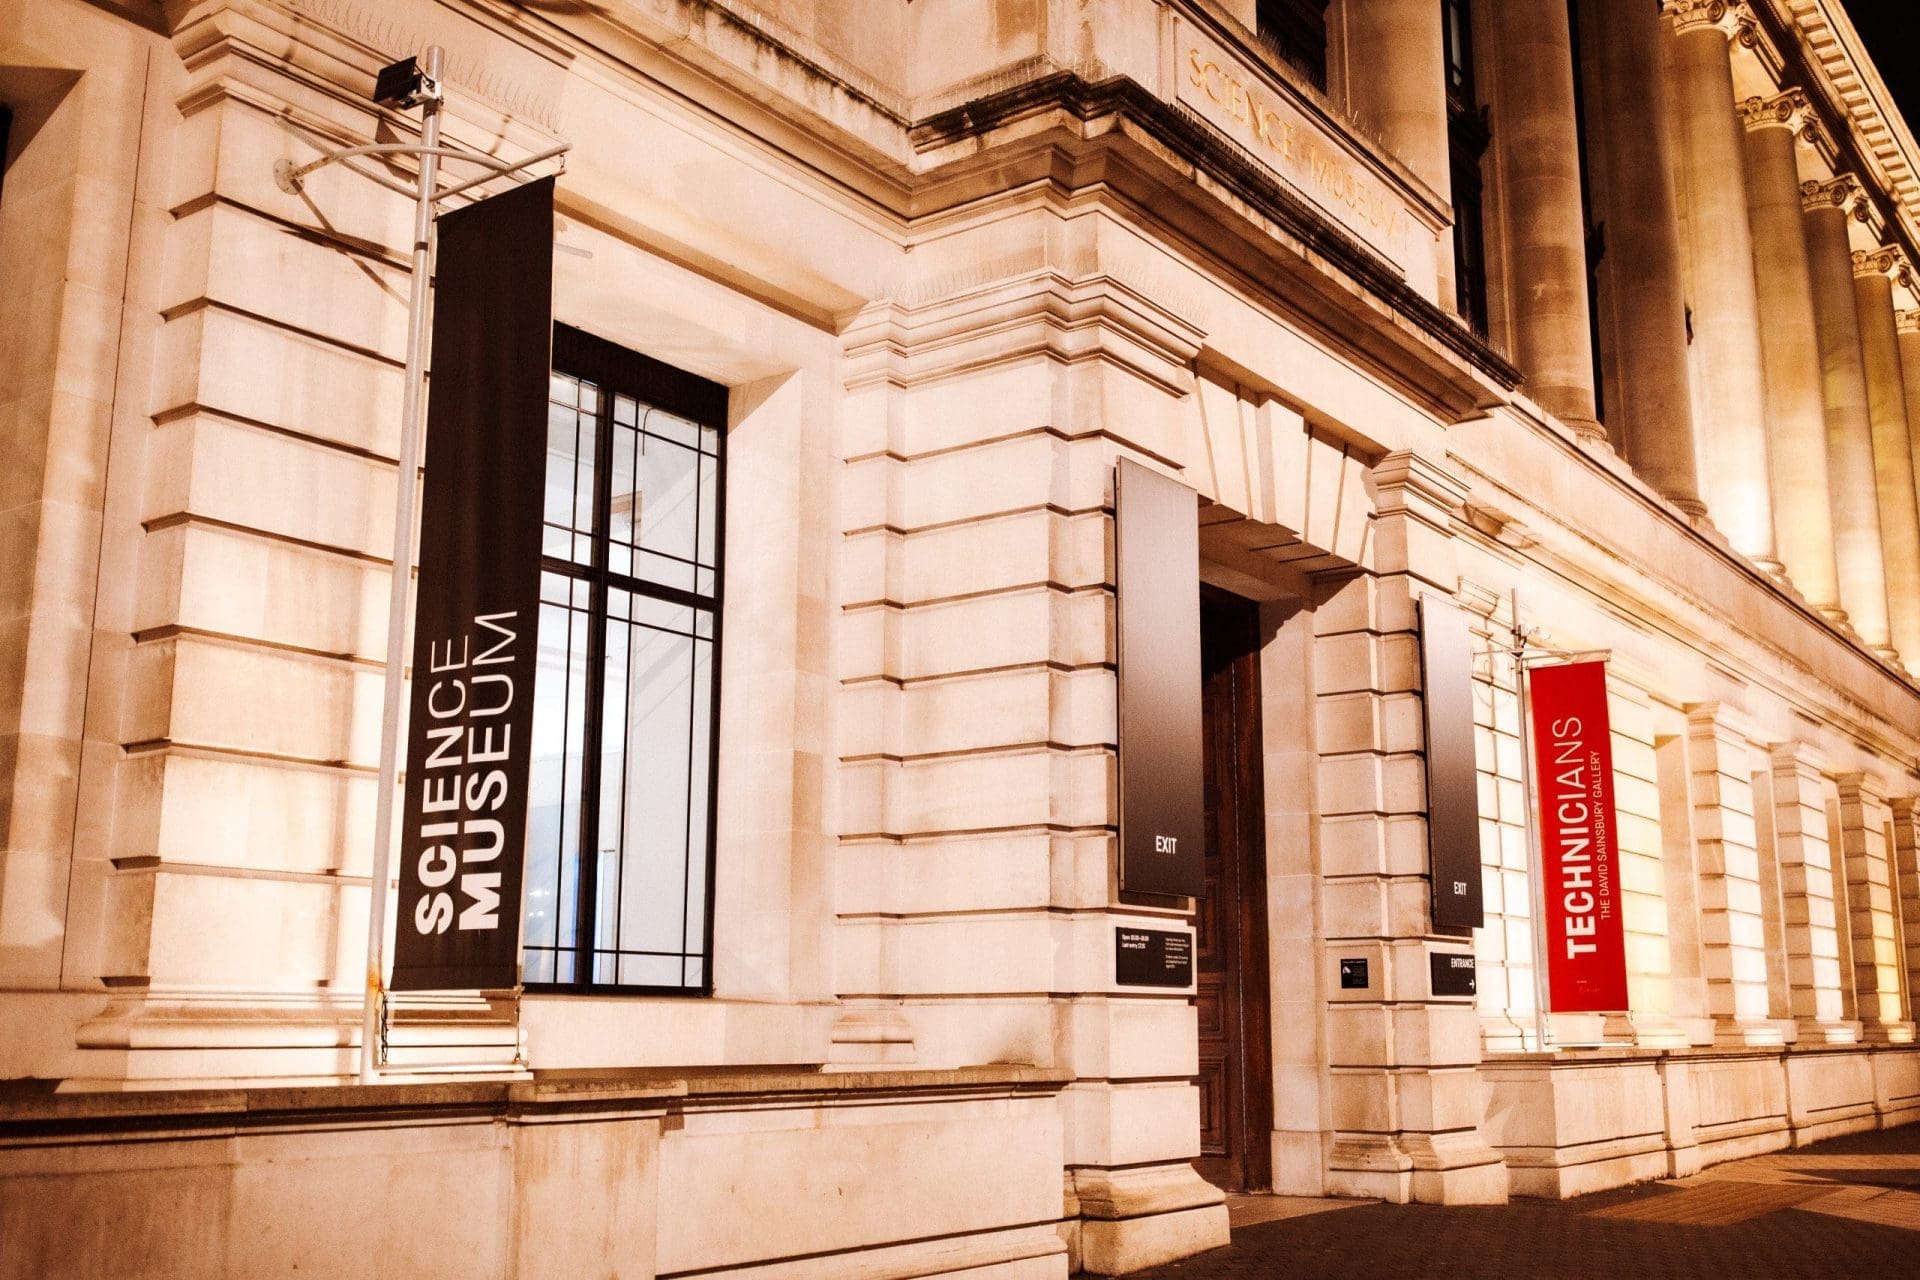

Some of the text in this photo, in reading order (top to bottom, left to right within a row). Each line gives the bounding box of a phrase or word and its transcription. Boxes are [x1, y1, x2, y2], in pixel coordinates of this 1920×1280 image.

[1189, 48, 1401, 240] SCIENCE MUSEUM
[415, 635, 468, 935] SCIENCE
[459, 611, 518, 930] MUSEUM
[1156, 836, 1177, 854] EXIT
[1552, 717, 1597, 960] TECHNICIANS
[1590, 750, 1612, 920] THE DAVID SAINSBURY GALLERY
[1451, 958, 1474, 968] ENTRANCE
[1454, 881, 1467, 895] EXIT
